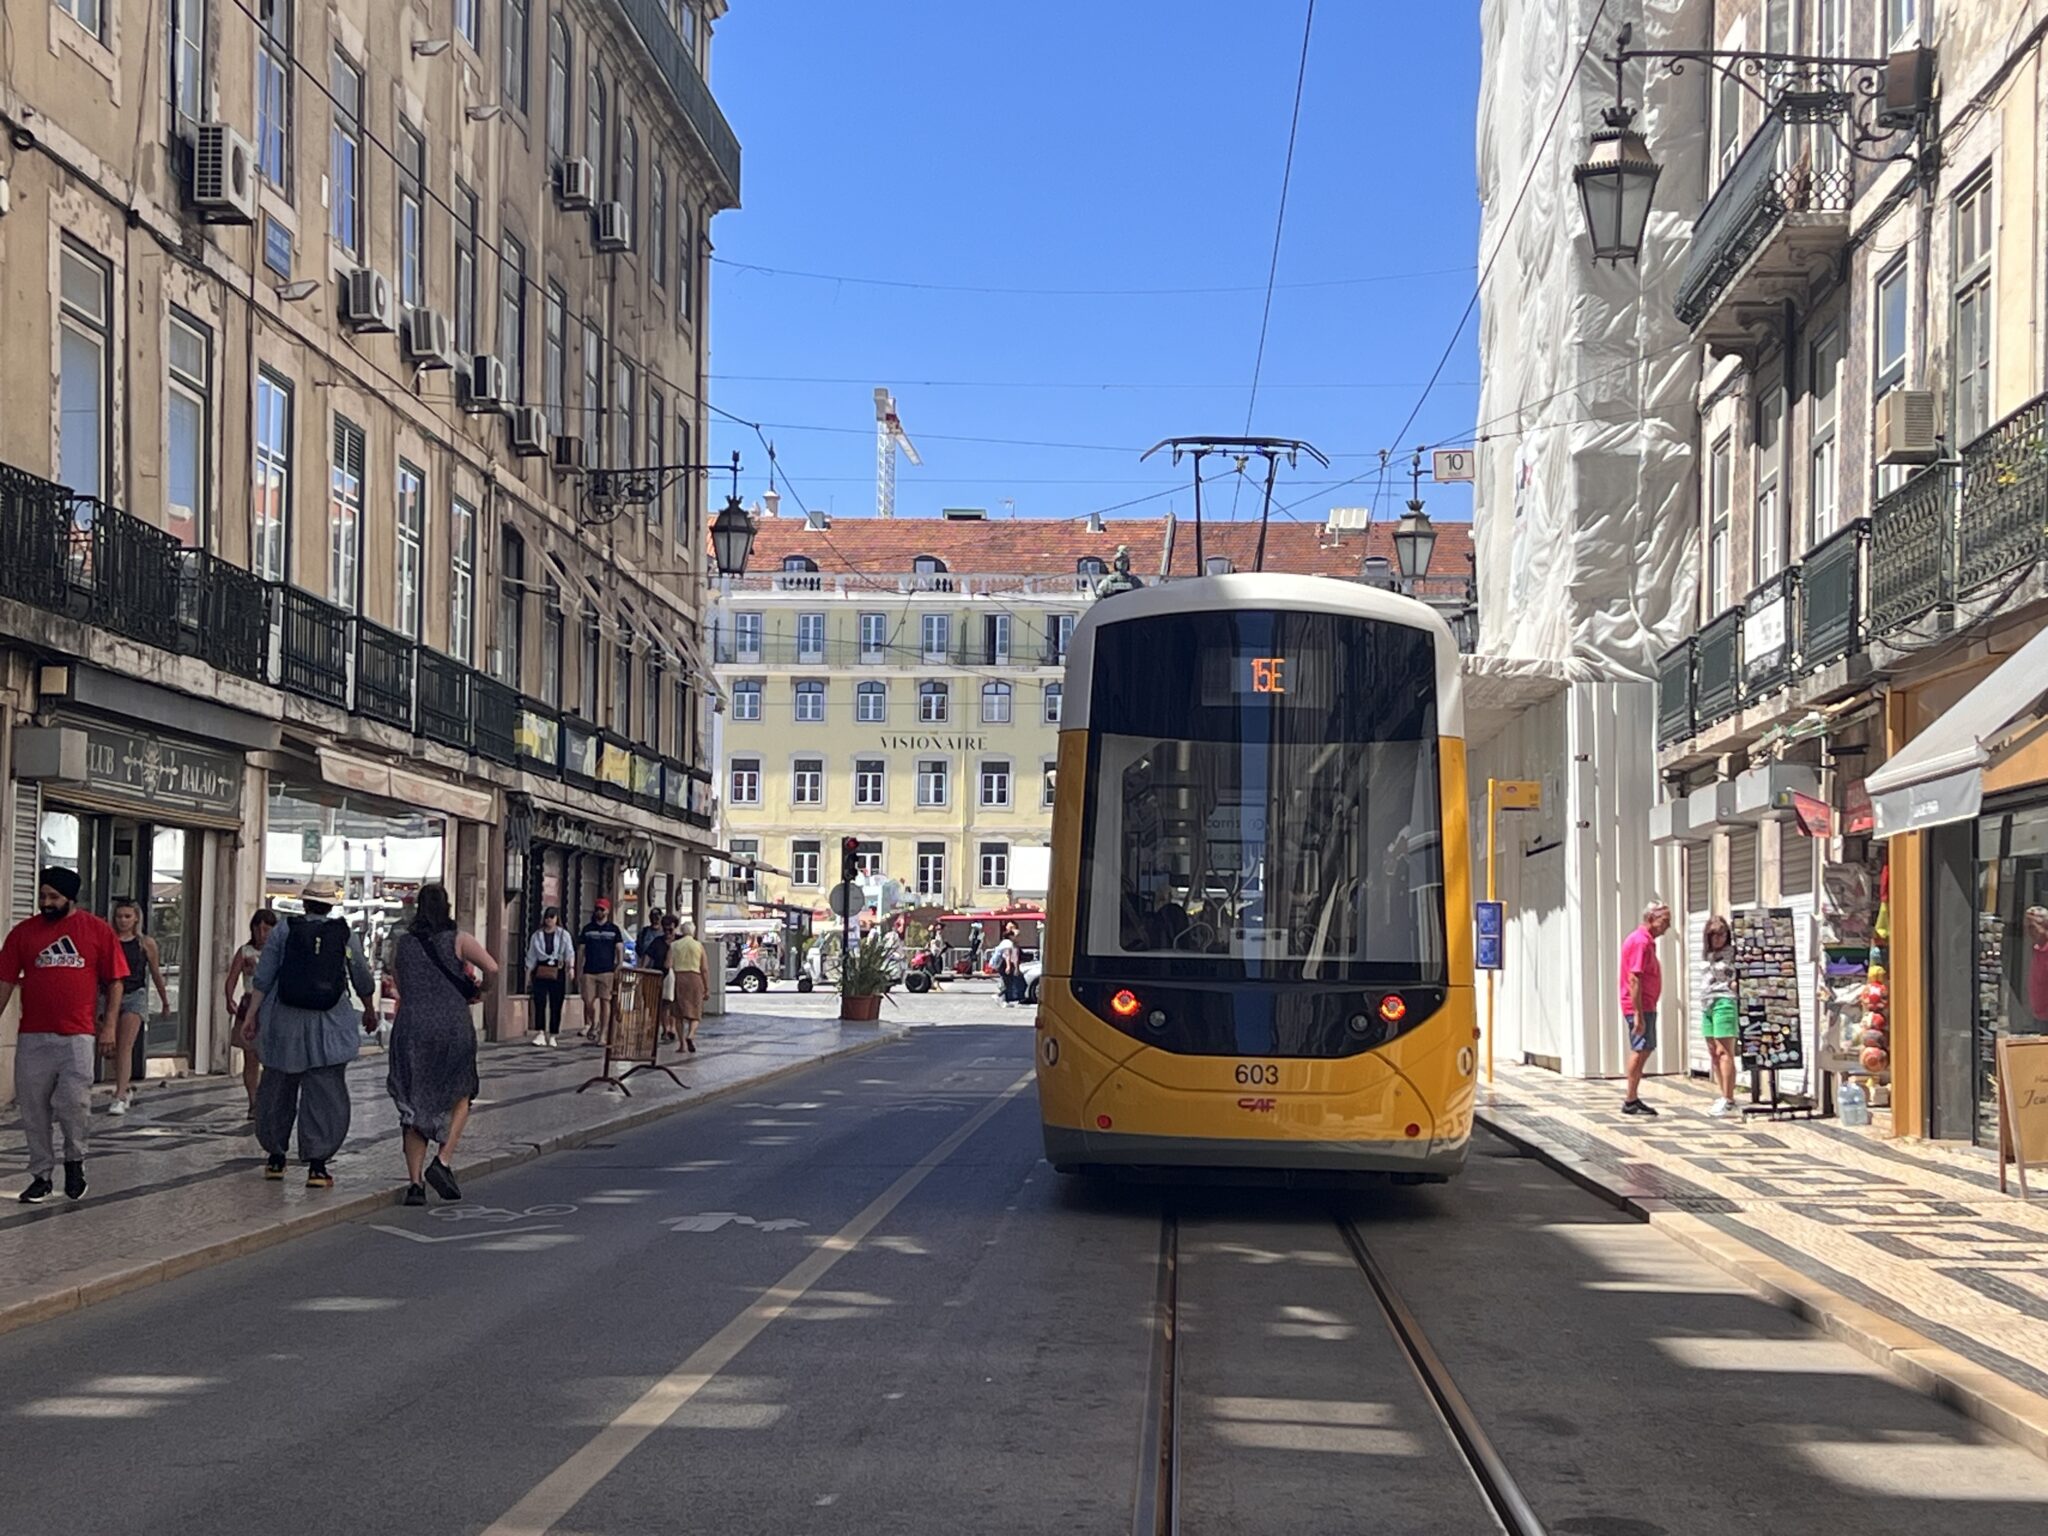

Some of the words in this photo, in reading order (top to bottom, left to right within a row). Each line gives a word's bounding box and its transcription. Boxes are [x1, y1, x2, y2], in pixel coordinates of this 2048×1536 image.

[1444, 453, 1464, 471] 10
[1250, 658, 1285, 692] 15E
[880, 736, 988, 750] VISIONAIRE
[87, 742, 115, 775] LUB
[181, 761, 217, 796] BALÃO
[1235, 1064, 1279, 1085] 603
[1237, 1098, 1278, 1113] CAF
